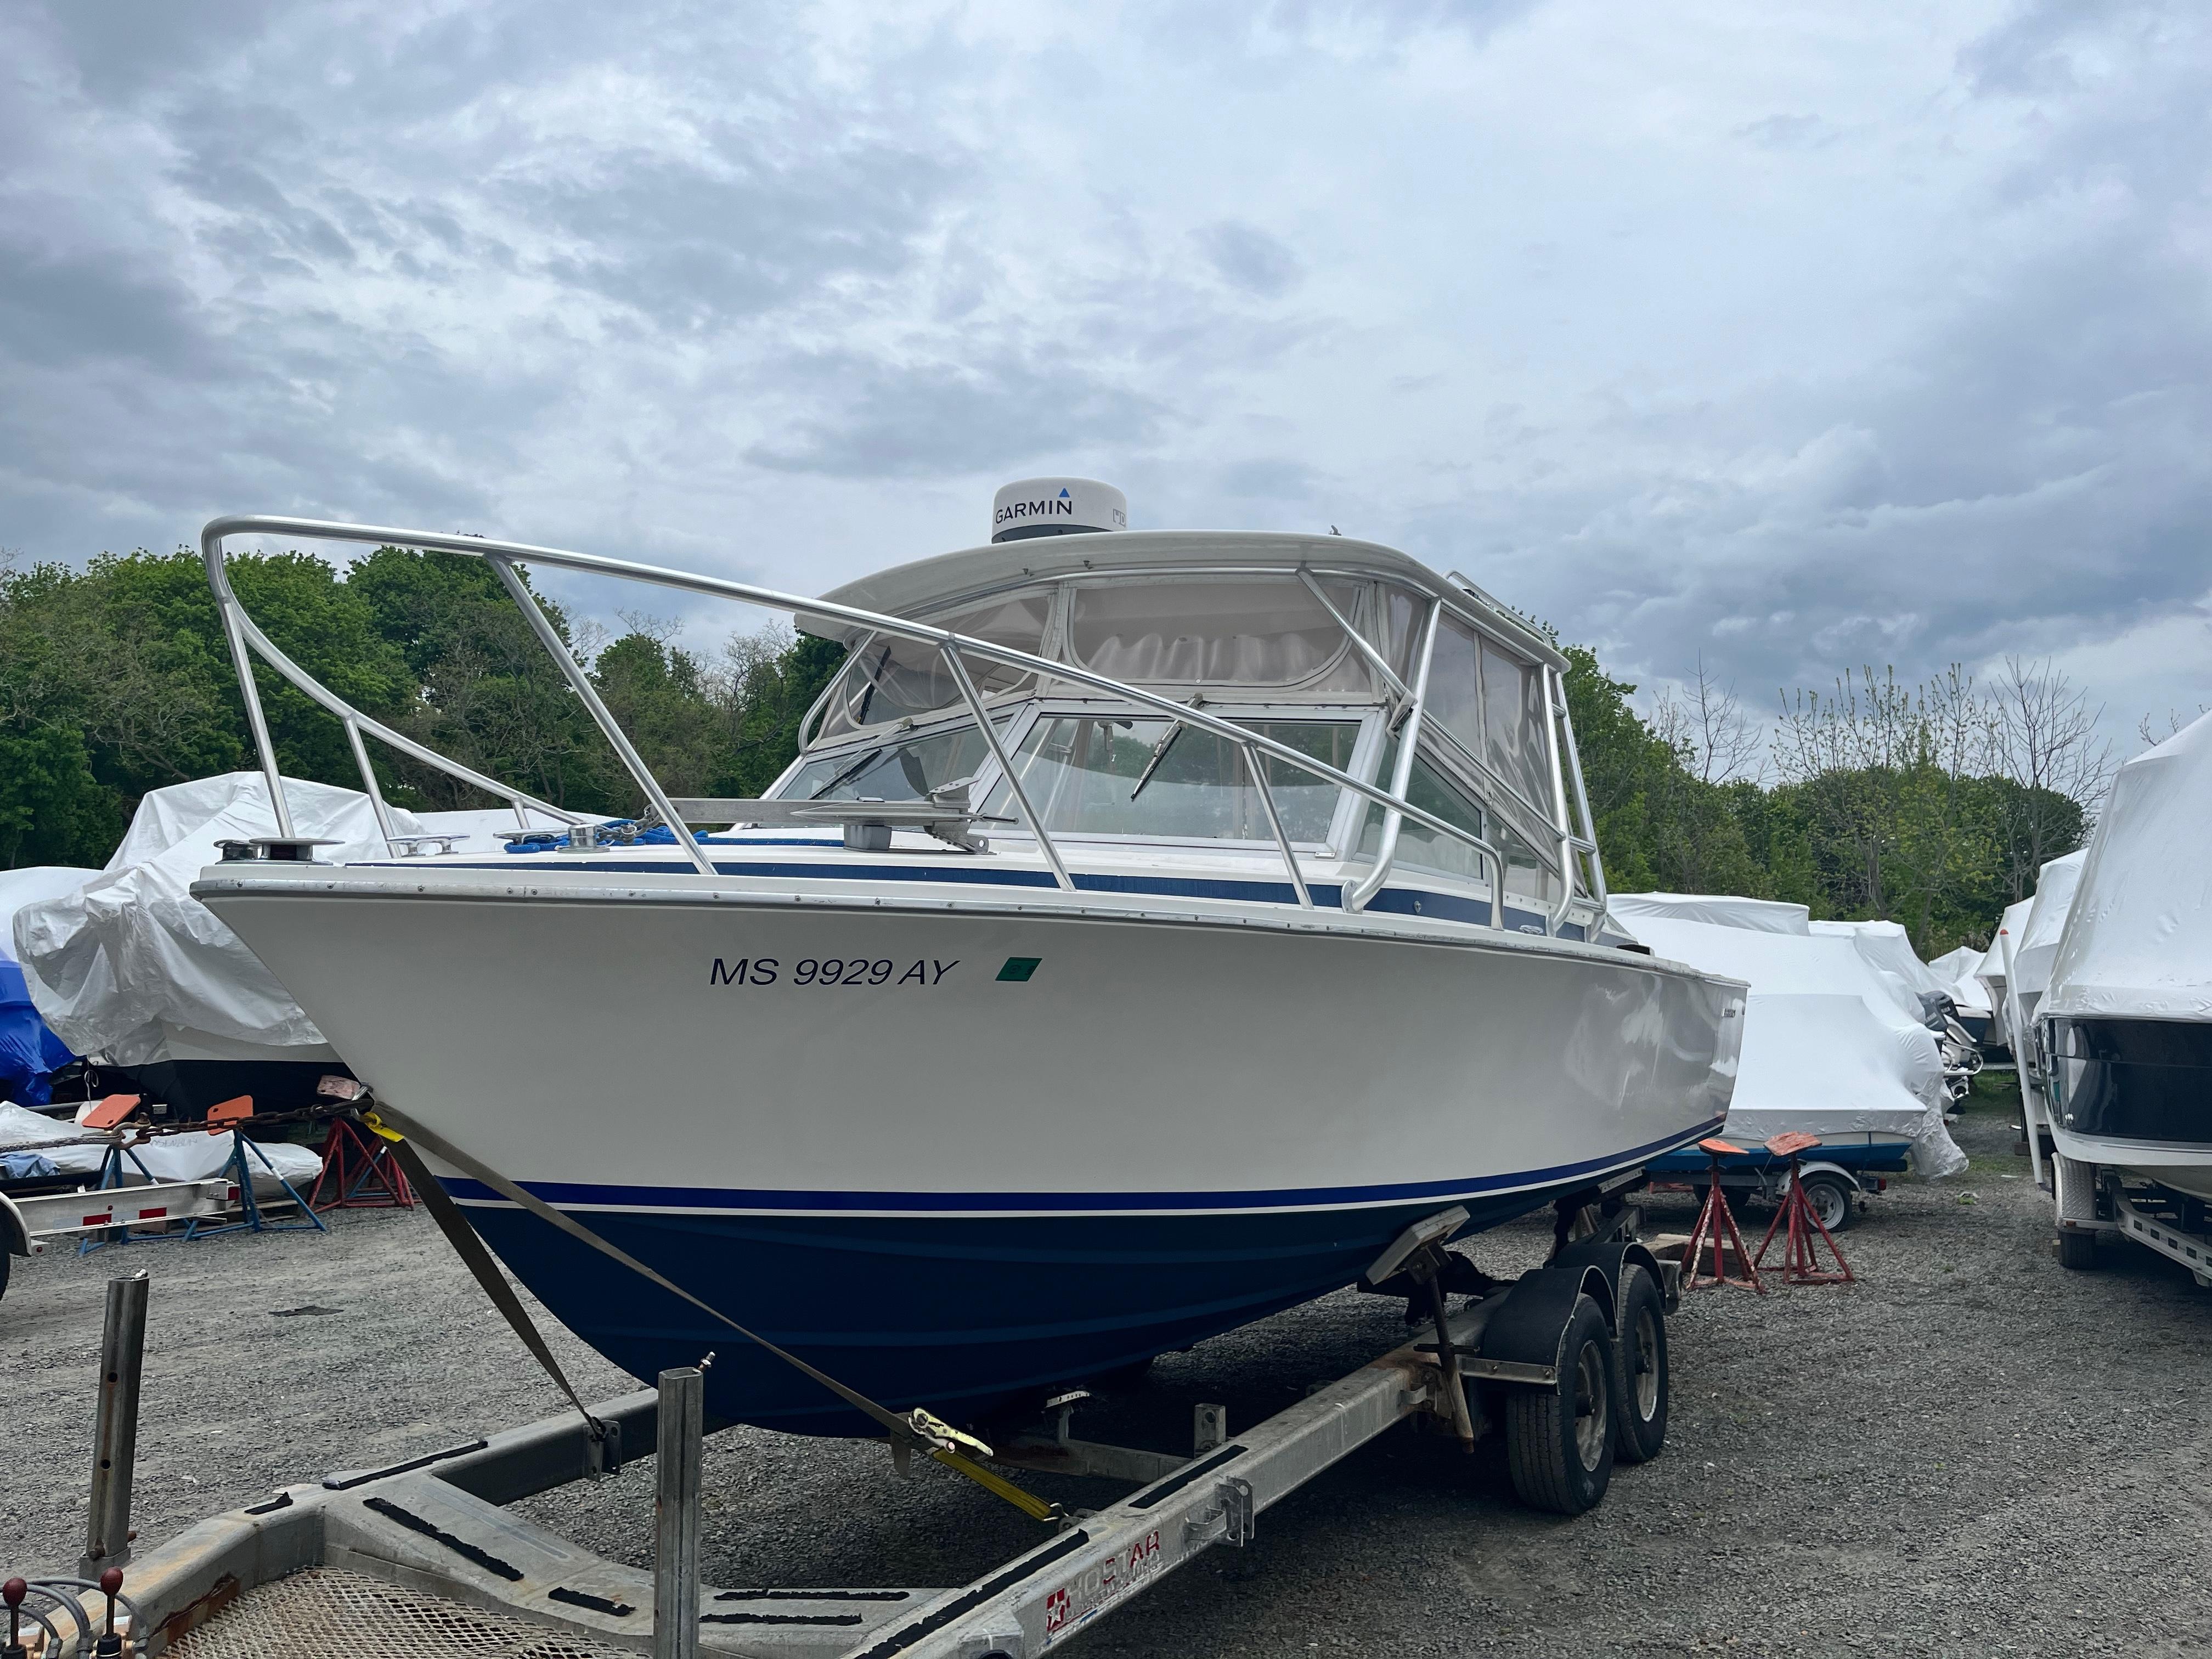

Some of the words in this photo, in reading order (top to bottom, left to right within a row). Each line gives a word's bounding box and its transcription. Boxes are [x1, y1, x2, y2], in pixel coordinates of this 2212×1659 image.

[995, 500, 1072, 524] GARMIN
[710, 958, 780, 985] MS
[794, 958, 894, 985] 9929
[897, 959, 961, 985] AY
